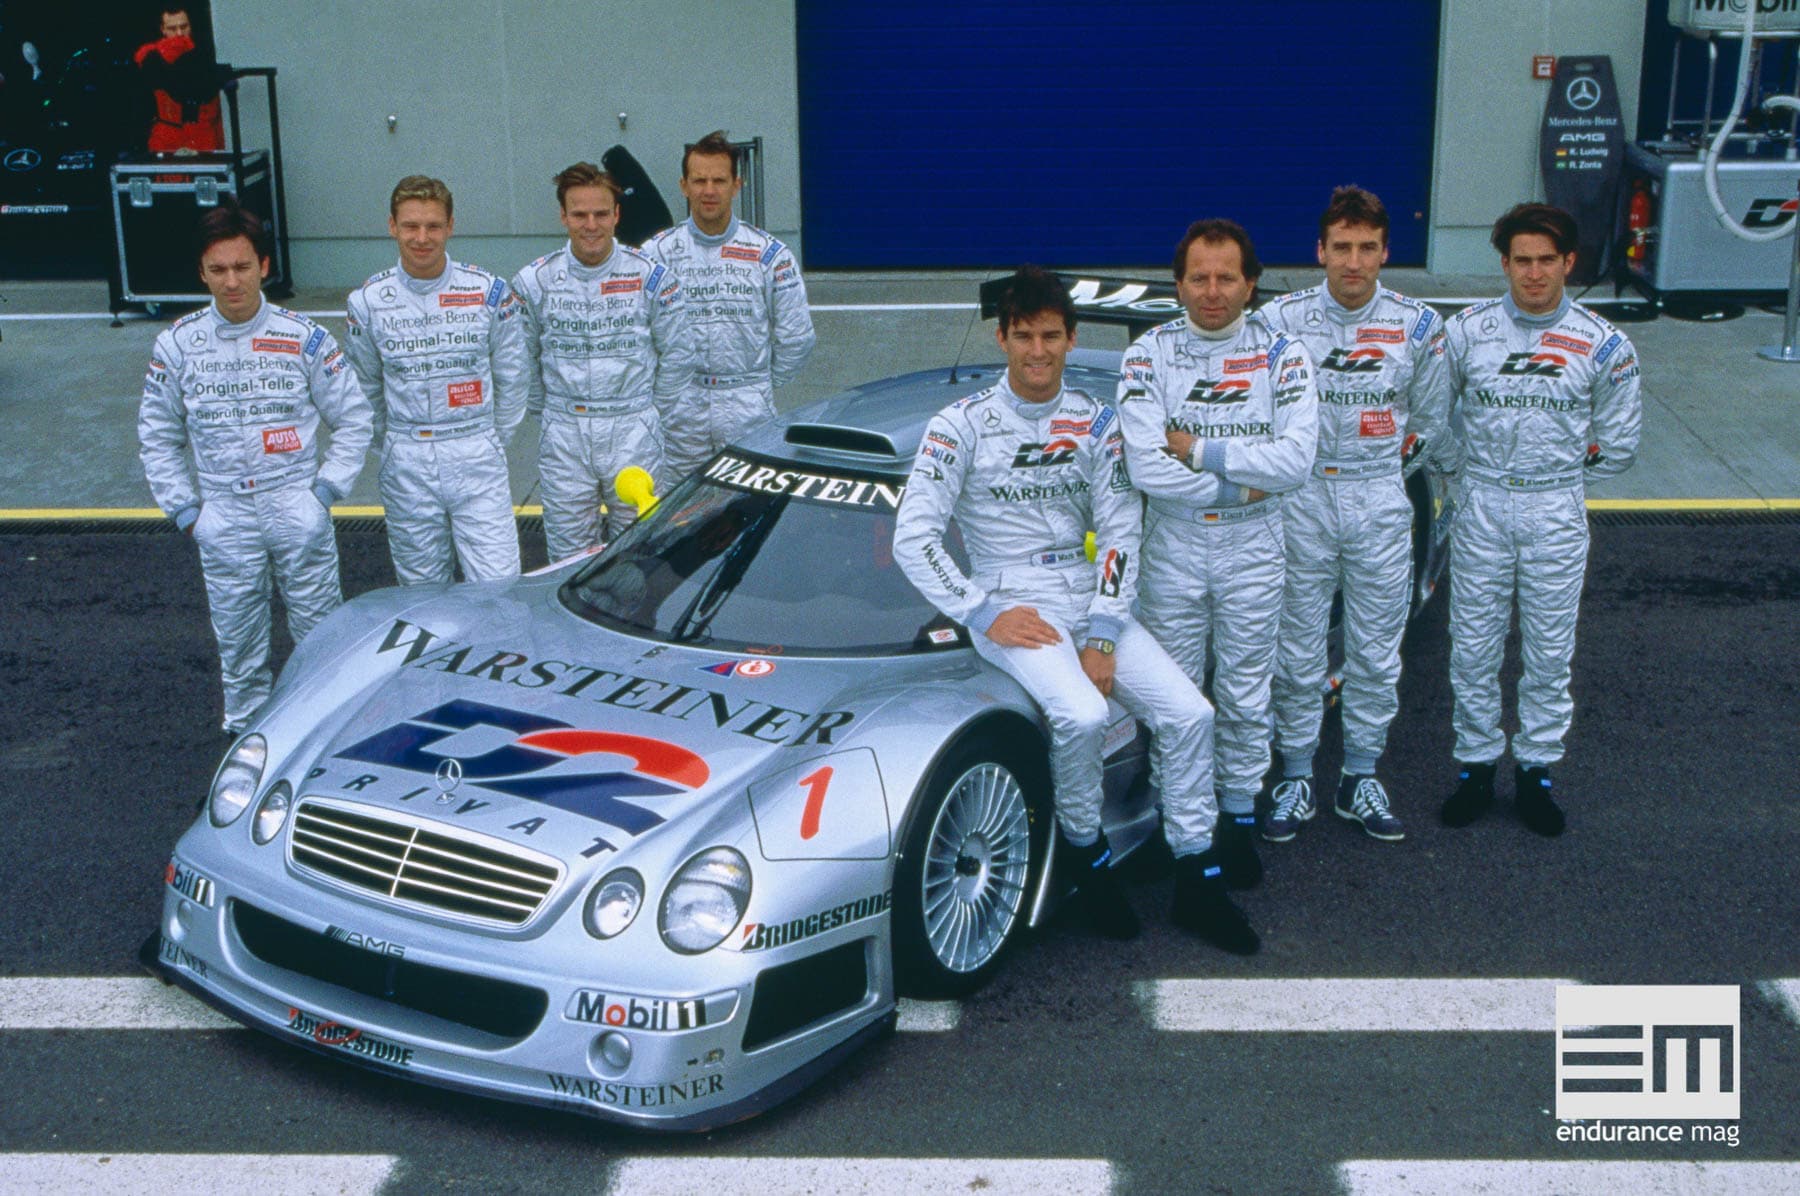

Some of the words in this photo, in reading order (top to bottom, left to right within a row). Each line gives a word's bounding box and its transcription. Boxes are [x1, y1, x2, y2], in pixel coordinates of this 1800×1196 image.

[1548, 117, 1617, 127] Mercedes-Benz
[1560, 132, 1606, 142] AMG
[1580, 147, 1609, 157] Ludwig
[1579, 161, 1602, 169] Zonta
[682, 282, 753, 297] riginal-Teile
[382, 311, 477, 331] Mercedes-Benz
[551, 315, 635, 333] Original-Teile
[385, 332, 479, 351] Original-Teile
[1559, 324, 1595, 339] AMG
[192, 356, 292, 374] Mercedes-Benz
[194, 377, 295, 397] Original-Teile
[1475, 389, 1579, 413] WARSTEINER
[196, 406, 247, 421] Geprüfte
[249, 404, 295, 417] Qualität
[267, 430, 297, 446] AUTO
[704, 456, 906, 509] WARSTEIN
[374, 618, 857, 749] WARSTEINER
[332, 698, 711, 838] D2
[799, 765, 834, 841] 1
[307, 767, 620, 860] PRIVAT
[165, 863, 195, 897] obil
[743, 889, 892, 951] BRIDGESTONE
[345, 931, 406, 958] AMG
[576, 990, 669, 1031] Mobil
[548, 1073, 726, 1108] WARSTEINER
